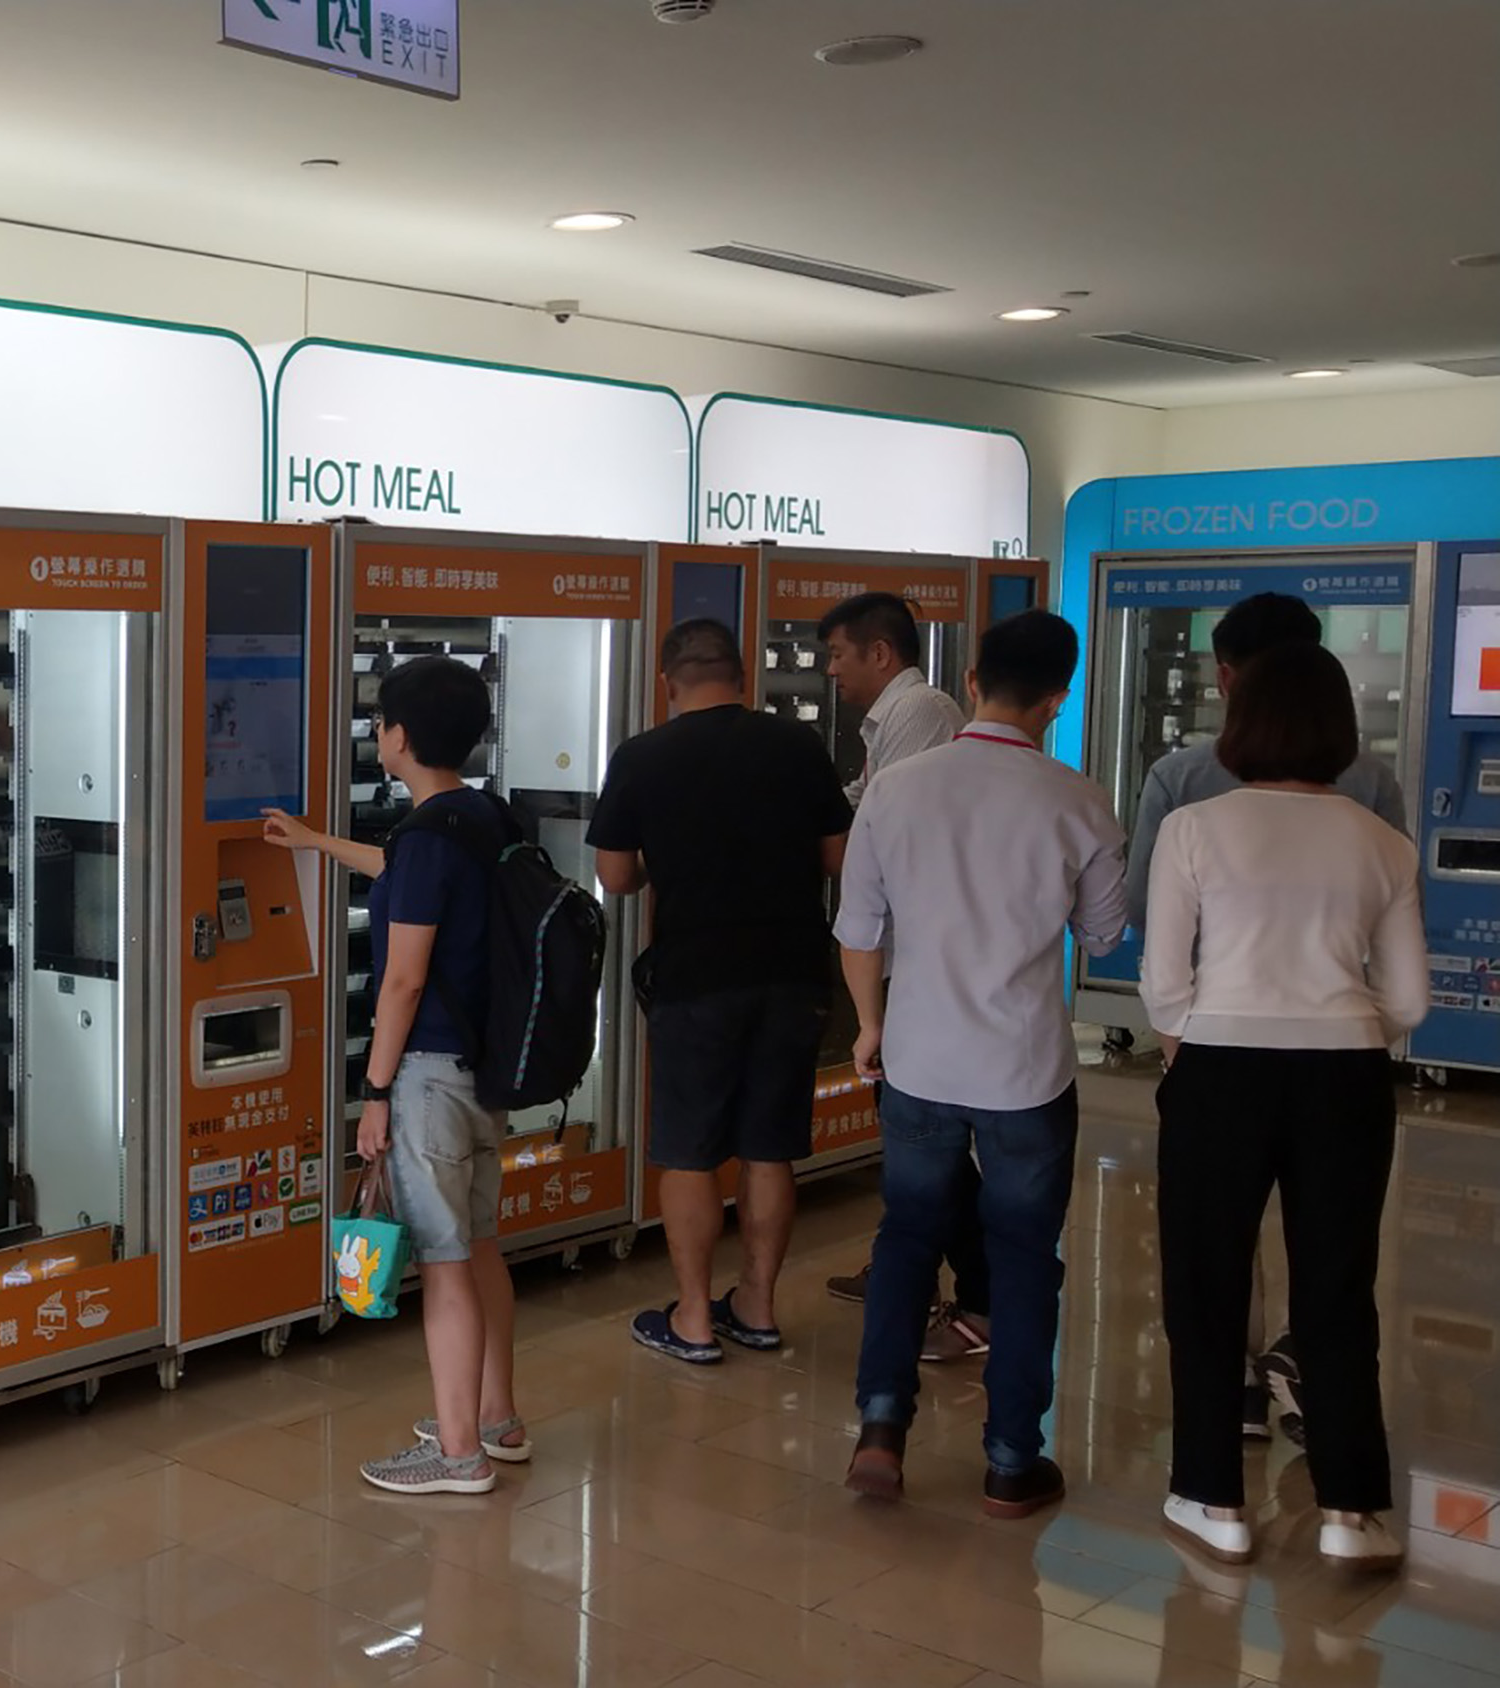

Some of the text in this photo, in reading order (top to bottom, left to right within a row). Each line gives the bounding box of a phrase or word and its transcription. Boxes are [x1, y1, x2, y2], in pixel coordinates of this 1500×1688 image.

[380, 12, 449, 52] 緊急出口
[382, 40, 448, 78] EXIT
[289, 456, 461, 514] HOT MEAL
[706, 490, 825, 535] HOT MEAL
[1123, 497, 1380, 535] FROZEN FOOD
